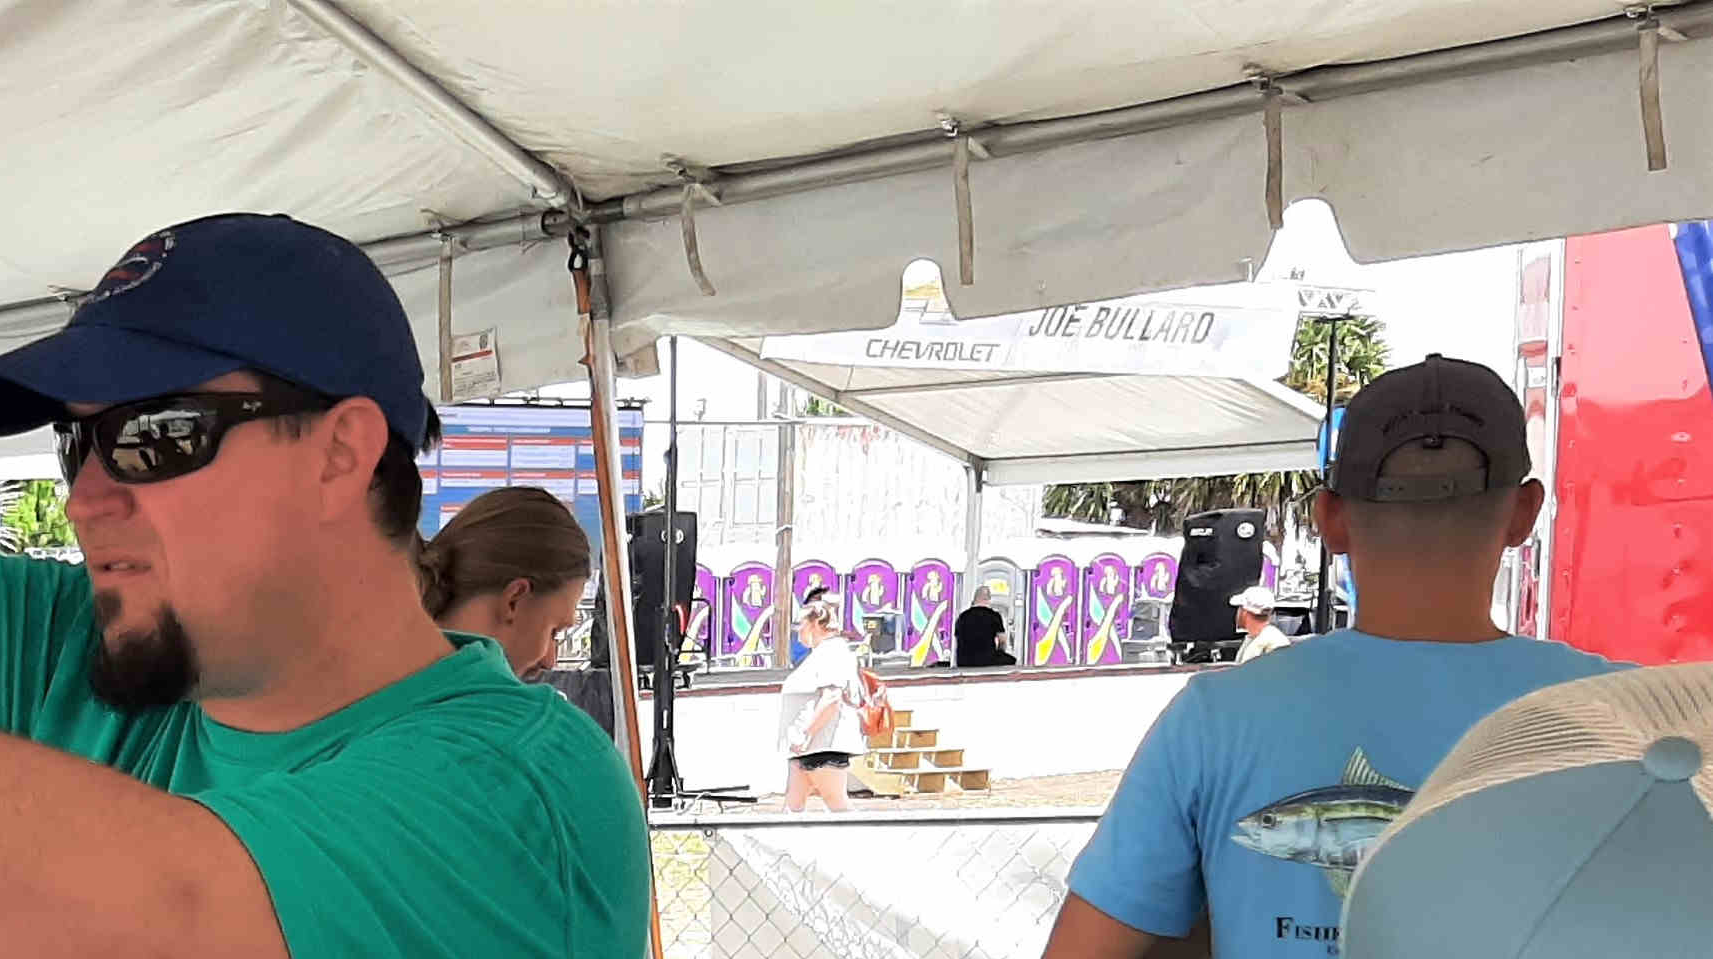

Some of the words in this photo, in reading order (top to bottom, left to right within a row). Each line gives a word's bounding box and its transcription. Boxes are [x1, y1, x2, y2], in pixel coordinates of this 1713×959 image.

[1029, 305, 1088, 338] JOE
[1086, 306, 1215, 345] BULLARD
[865, 338, 1001, 363] CHEVROLET
